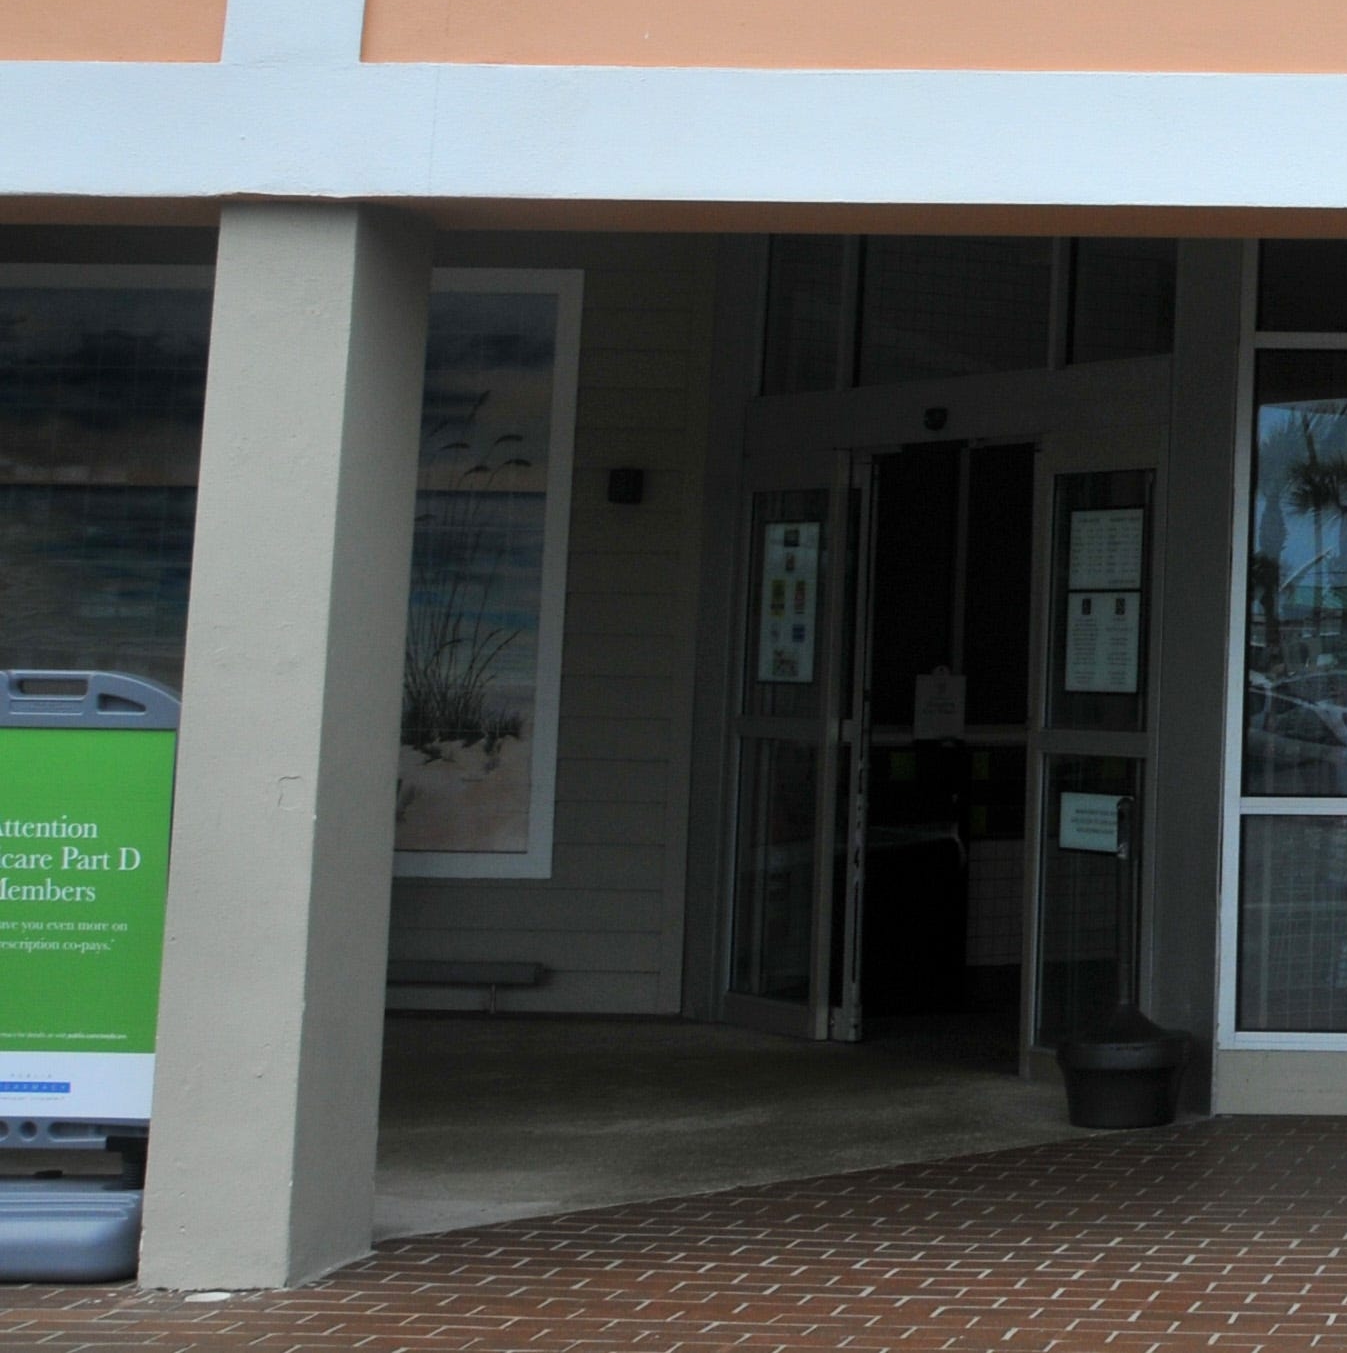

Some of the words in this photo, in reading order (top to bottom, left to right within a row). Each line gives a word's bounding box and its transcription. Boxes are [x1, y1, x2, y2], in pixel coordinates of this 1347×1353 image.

[61, 846, 111, 871] Part
[118, 847, 142, 871] D
[21, 921, 44, 934] you
[46, 921, 75, 932] even
[77, 922, 108, 932] more
[111, 922, 129, 933] on
